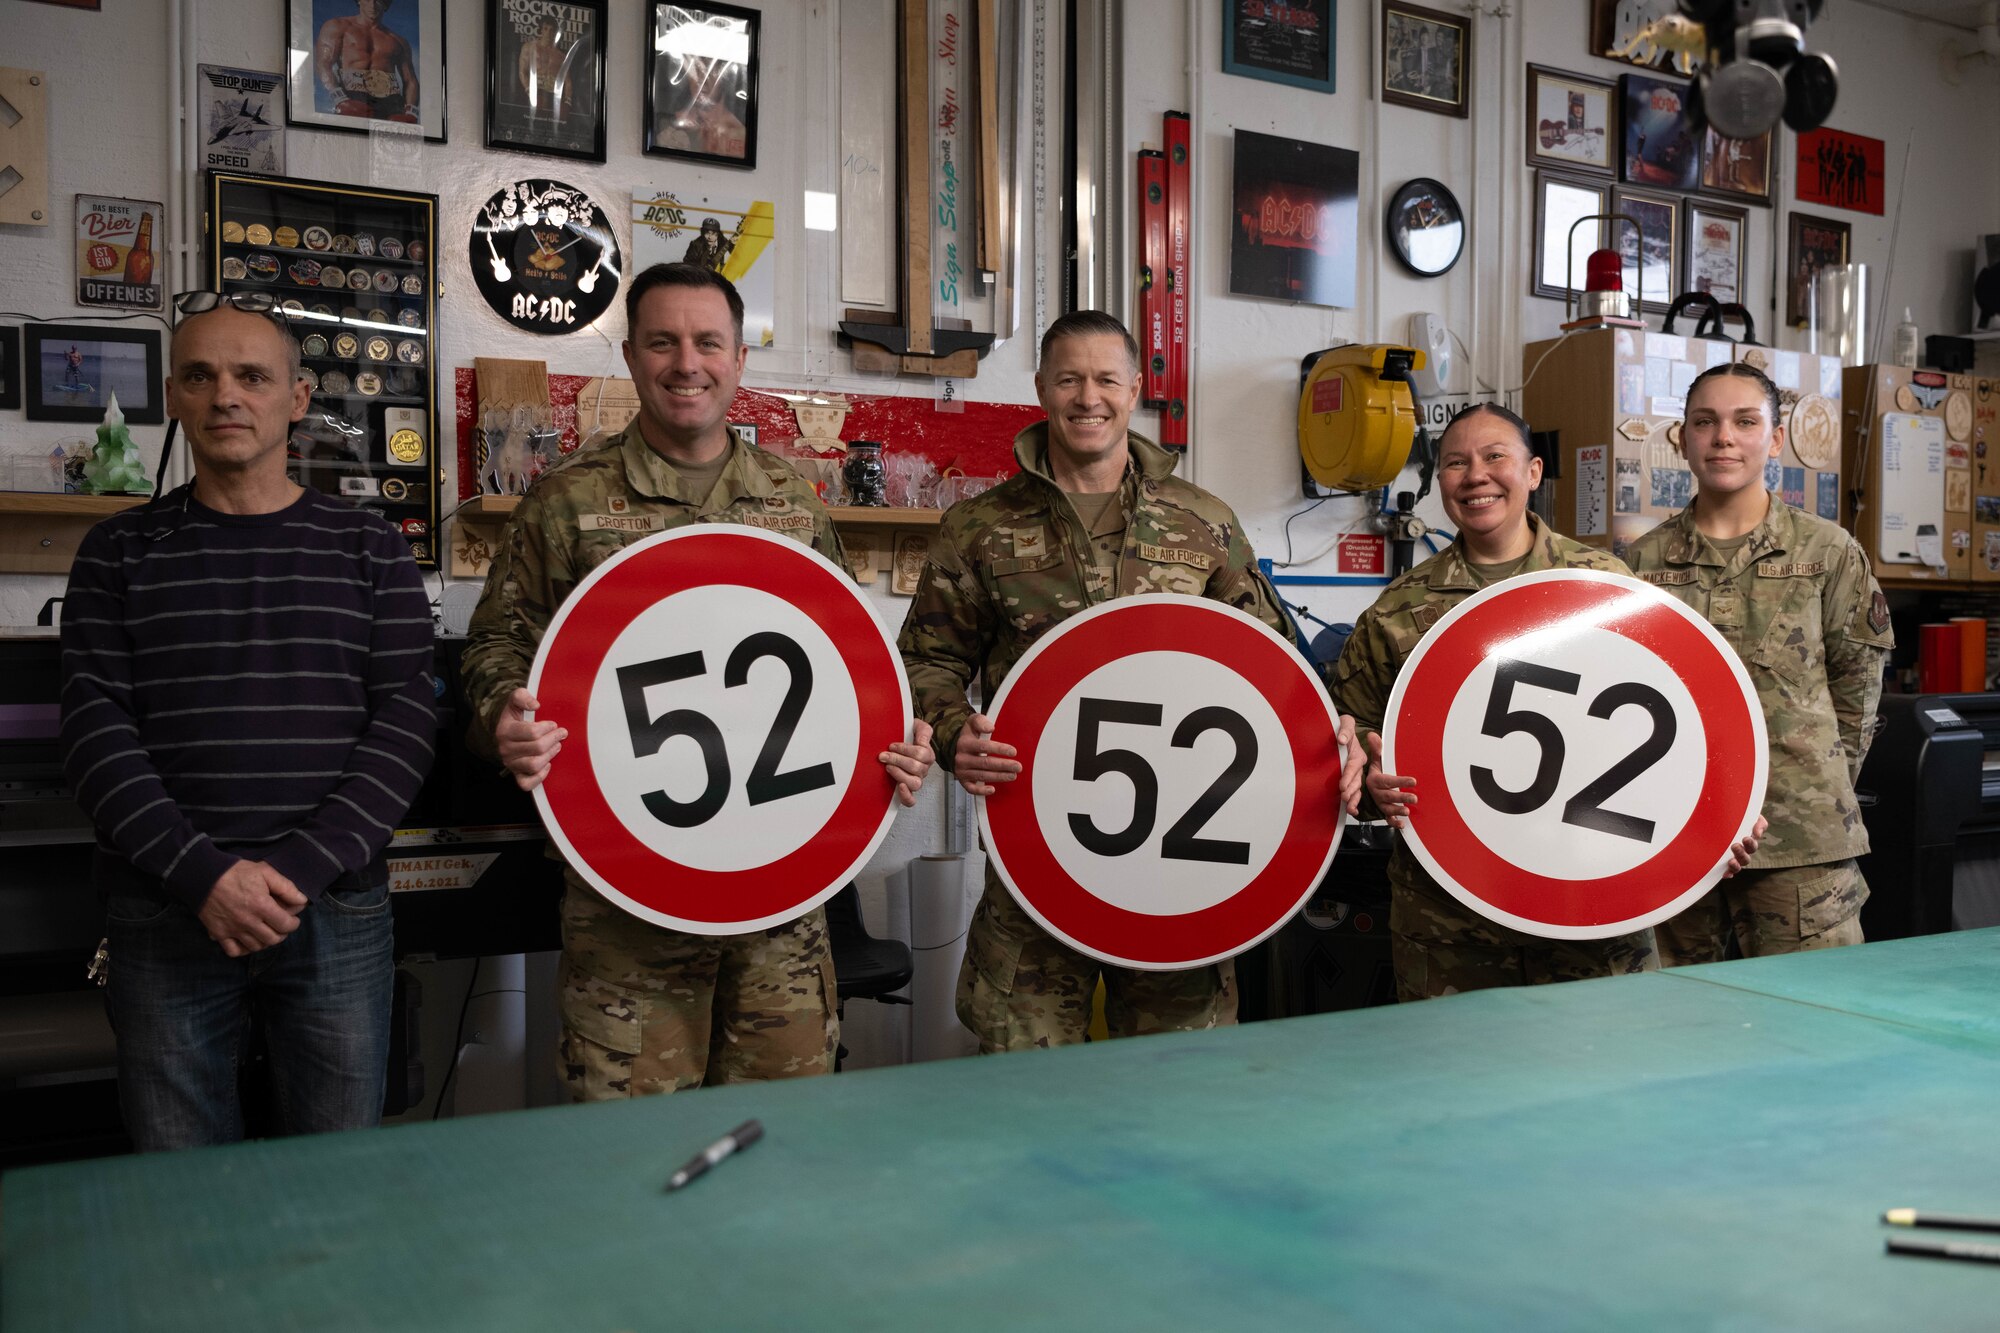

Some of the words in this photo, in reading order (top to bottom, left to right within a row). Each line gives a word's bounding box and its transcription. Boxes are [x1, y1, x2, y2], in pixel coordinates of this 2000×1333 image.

[502, 0, 567, 19] ROCKY
[570, 7, 591, 23] III
[938, 13, 960, 66] Shop
[223, 76, 240, 87] TOP
[241, 78, 261, 90] GUN
[208, 153, 249, 168] SPEED
[938, 161, 960, 231] Shop
[92, 204, 106, 212] DAS
[108, 205, 130, 215] BESTE
[81, 212, 137, 237] Bier
[93, 246, 108, 258] IST
[1175, 227, 1184, 262] SHOP
[96, 257, 113, 268] EIN
[940, 242, 962, 307] Sign
[1175, 265, 1184, 296] SIGN
[86, 283, 155, 303] OFFENES
[1175, 299, 1184, 324] CES
[1175, 328, 1183, 344] 52
[943, 380, 955, 404] Sign
[1424, 403, 1456, 425] IGN
[596, 516, 651, 530] CROFTON
[763, 515, 780, 529] AIR
[781, 515, 813, 529] FORCE
[1159, 548, 1176, 561] AIR
[1178, 551, 1206, 567] FORCE
[1643, 572, 1691, 584] MACKEWICH
[1761, 562, 1779, 576] U.S.
[1780, 563, 1794, 576] AIR
[1796, 560, 1824, 575] FORCE
[616, 631, 836, 828] 52
[1469, 660, 1677, 843] 52
[1067, 697, 1258, 865] 52
[444, 859, 475, 869] Gek.
[394, 876, 460, 890] 24.6.2021
